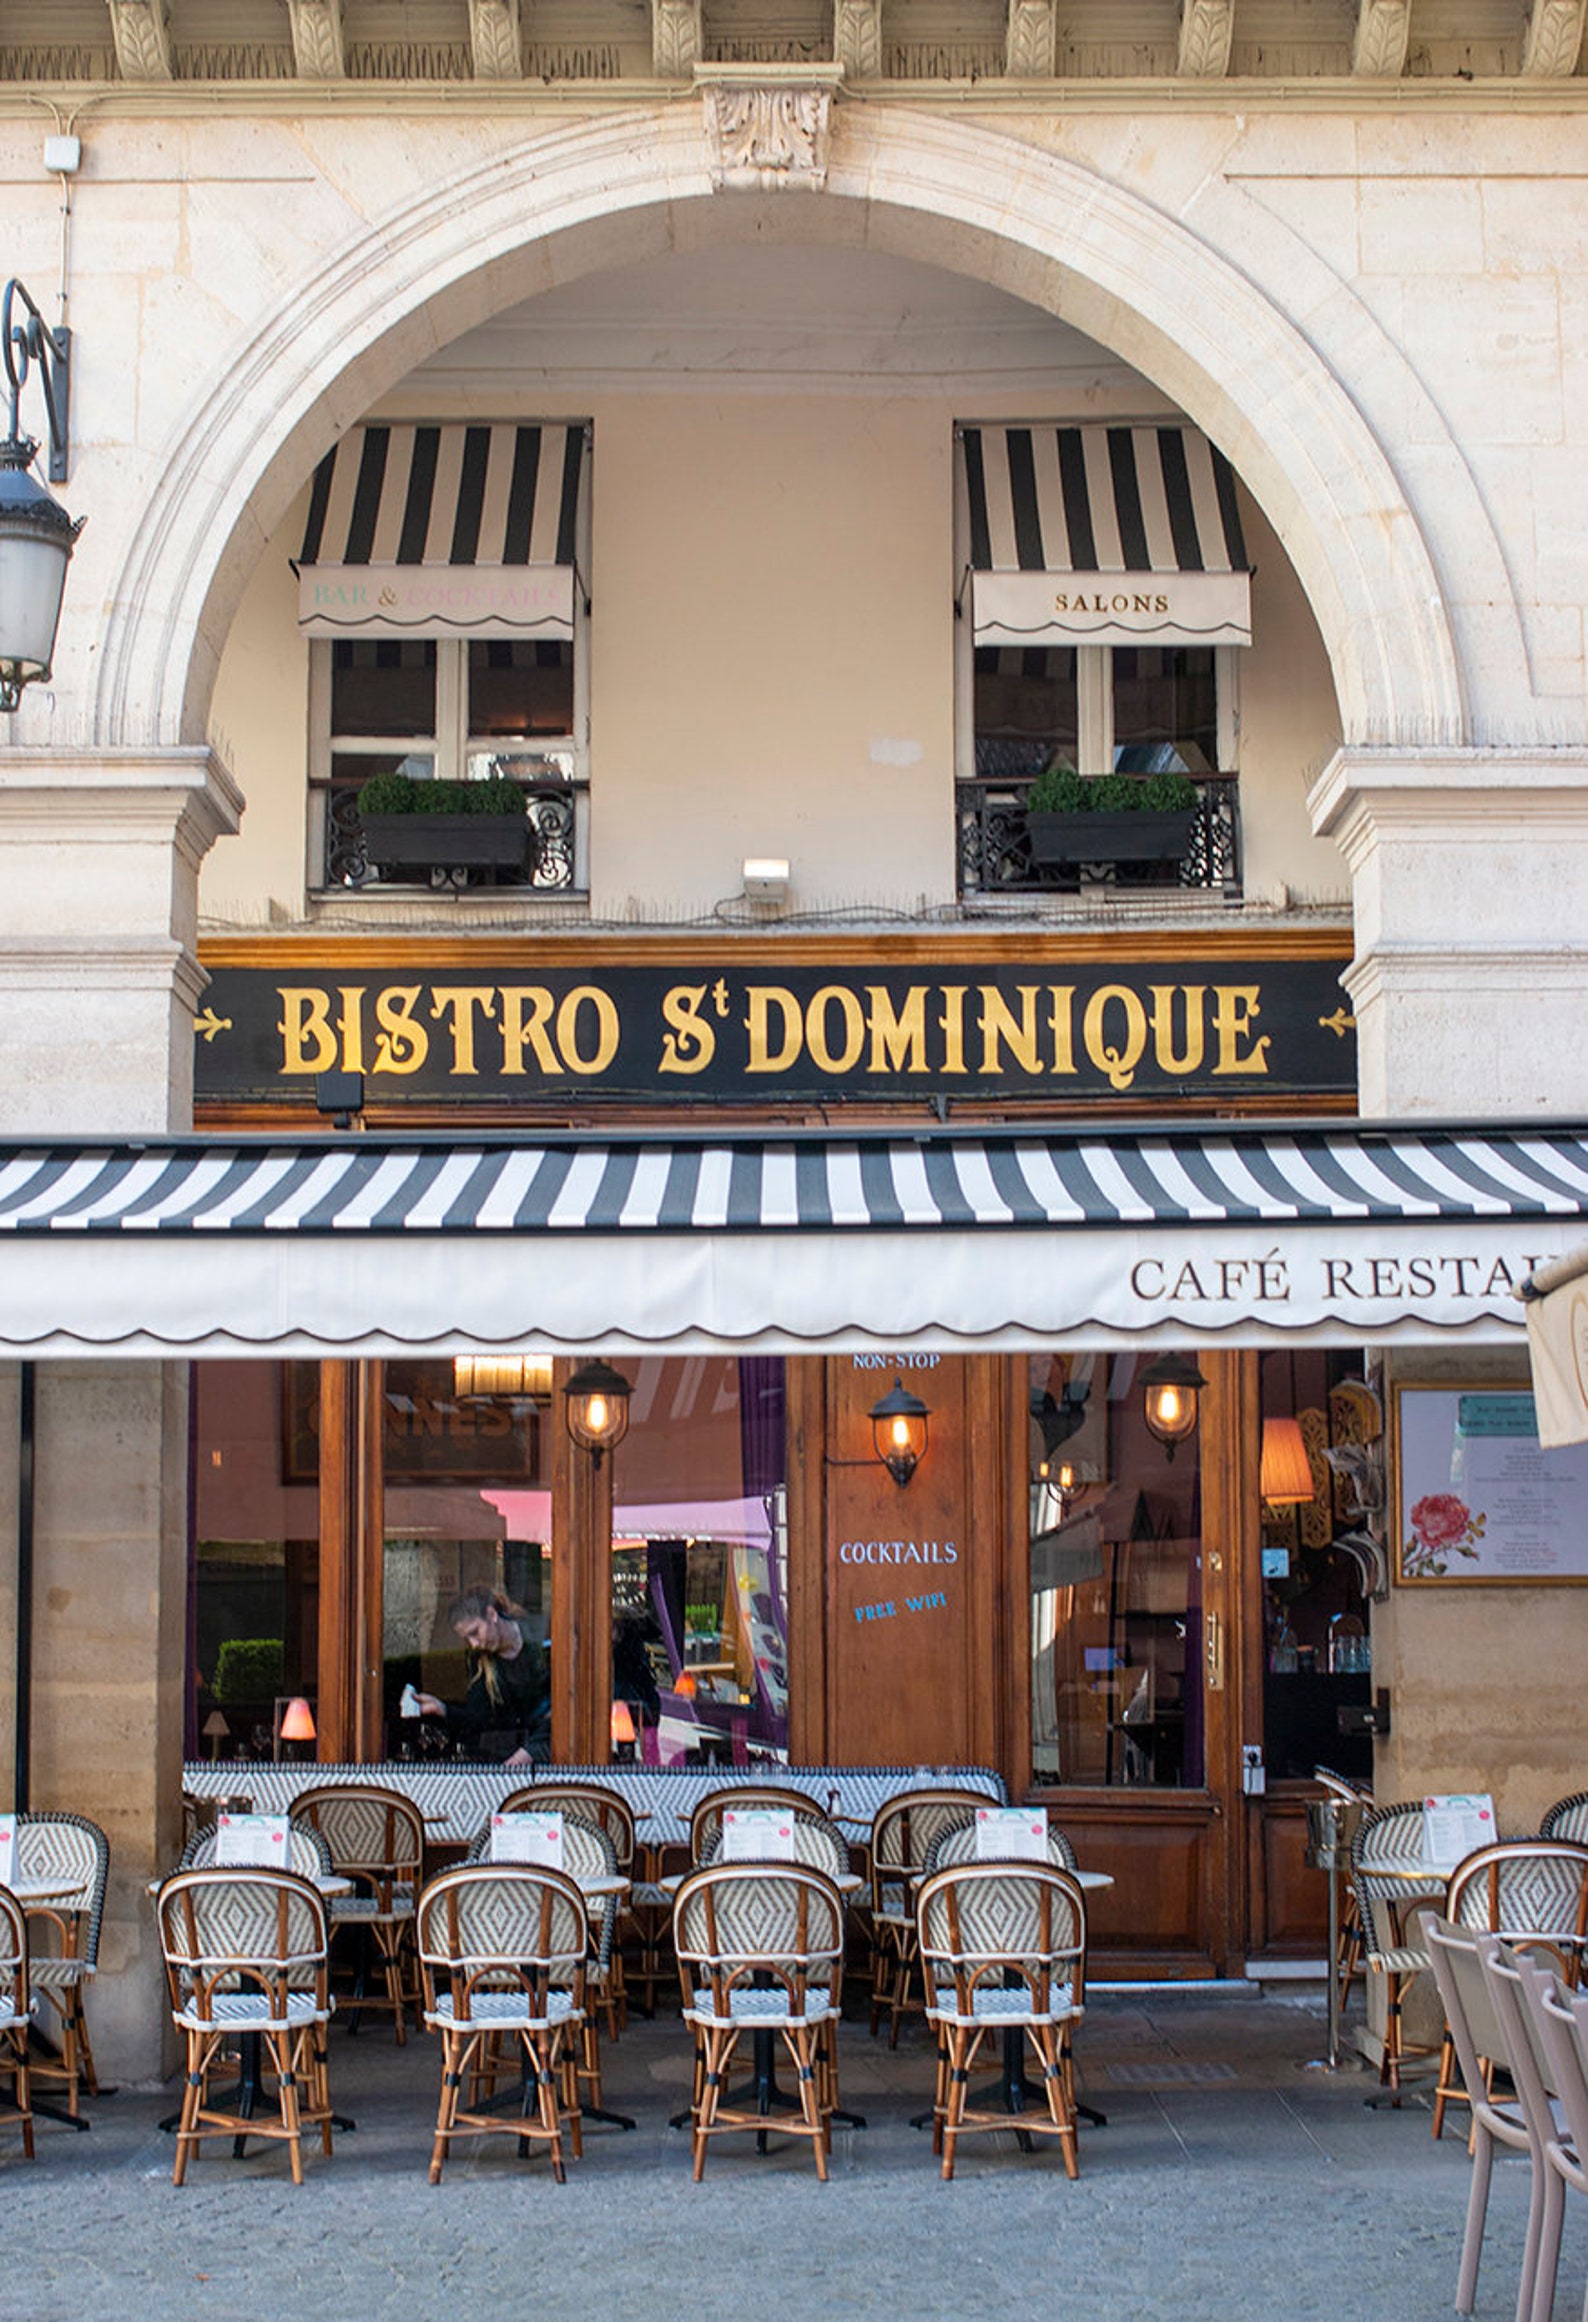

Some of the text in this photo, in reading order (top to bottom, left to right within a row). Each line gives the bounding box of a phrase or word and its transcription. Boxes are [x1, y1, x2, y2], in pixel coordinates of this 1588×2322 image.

[313, 584, 563, 608] BAR & COCKTAILS
[1055, 594, 1170, 613] SALONS
[276, 978, 1271, 1090] BISTRO St DOMINIQUE
[1130, 1247, 1291, 1301] CAFÉ
[839, 1542, 958, 1565] COCKTAILS
[855, 1591, 947, 1624] FREE WIFI
